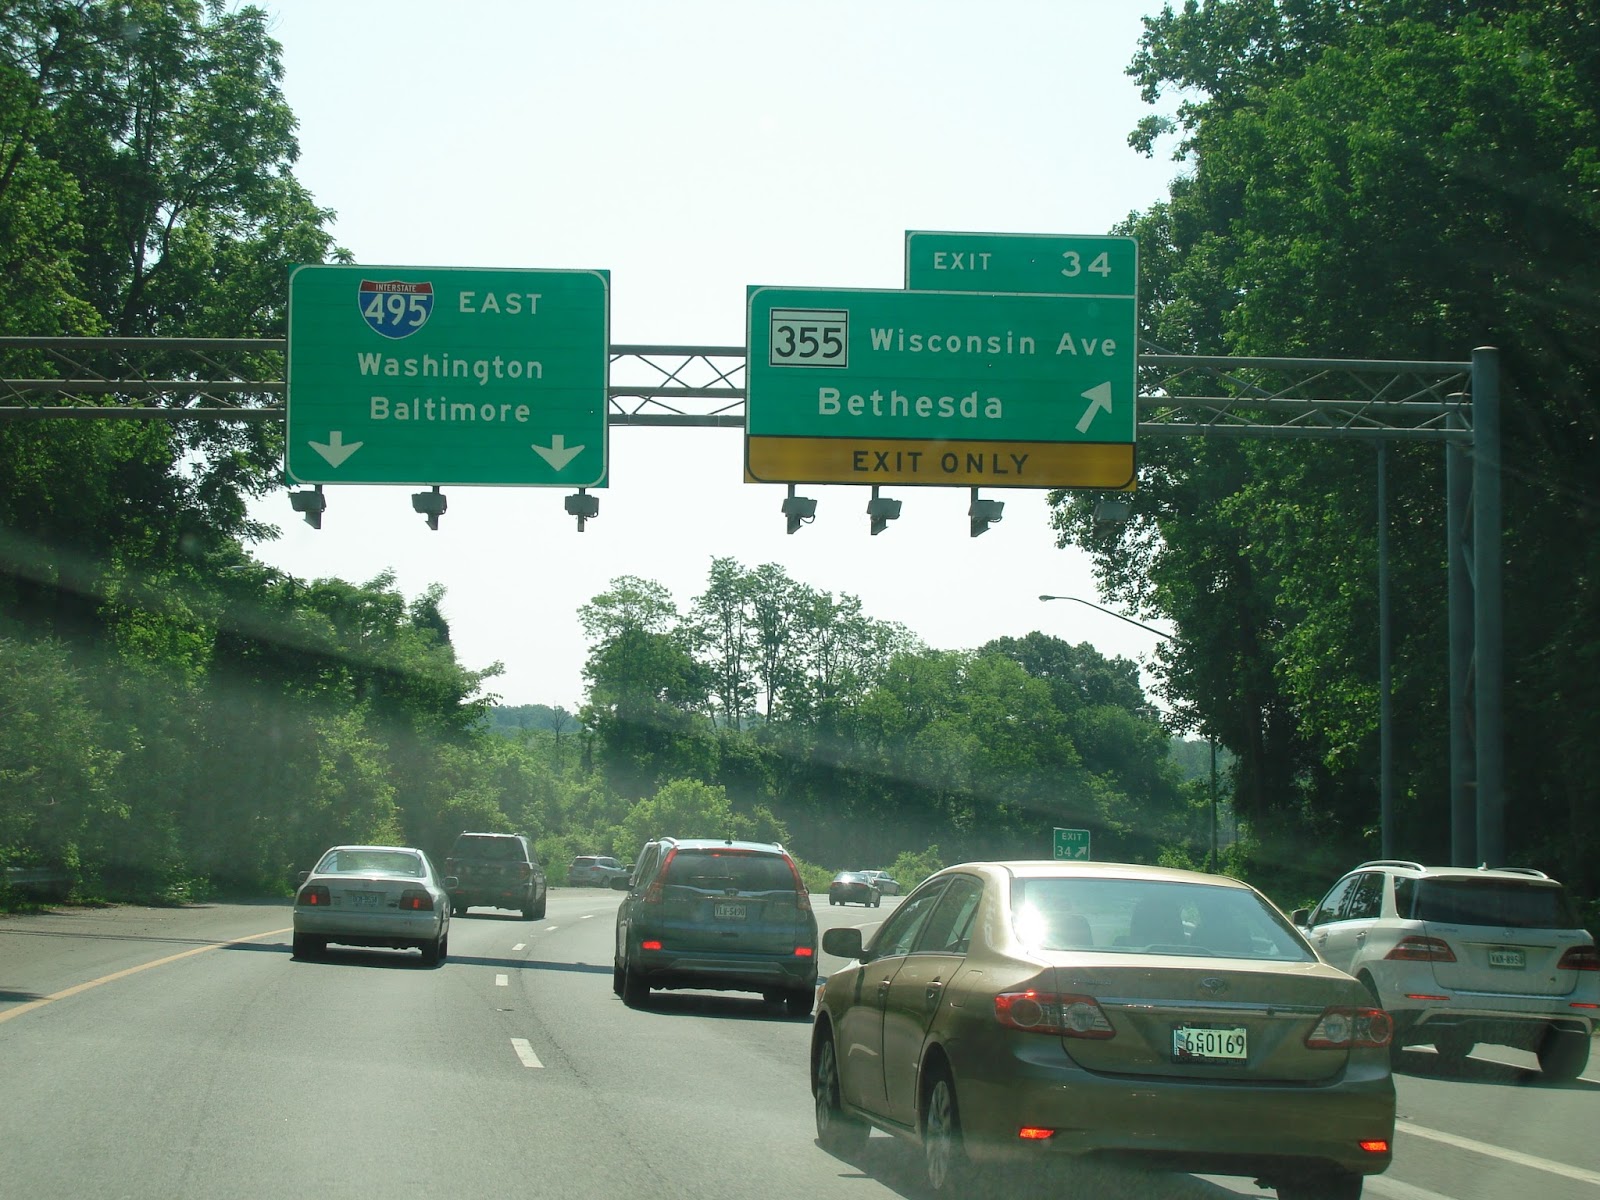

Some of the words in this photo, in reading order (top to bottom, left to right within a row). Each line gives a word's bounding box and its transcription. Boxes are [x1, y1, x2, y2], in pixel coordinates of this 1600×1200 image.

[933, 252, 992, 271] EXIT
[1061, 251, 1112, 278] 34
[375, 283, 417, 293] INTERSTATE
[364, 294, 427, 326] 495
[459, 292, 542, 314] EAST
[775, 326, 843, 359] 355
[870, 328, 1035, 355] Wisconsin
[1055, 332, 1117, 356] Ave
[358, 352, 543, 386] Washington
[370, 396, 531, 423] Baltimore
[818, 387, 1003, 419] Bethesda
[852, 450, 923, 473] EXIT
[941, 452, 1029, 475] ONLY
[1062, 833, 1082, 841] EXIT
[1057, 846, 1071, 856] 34
